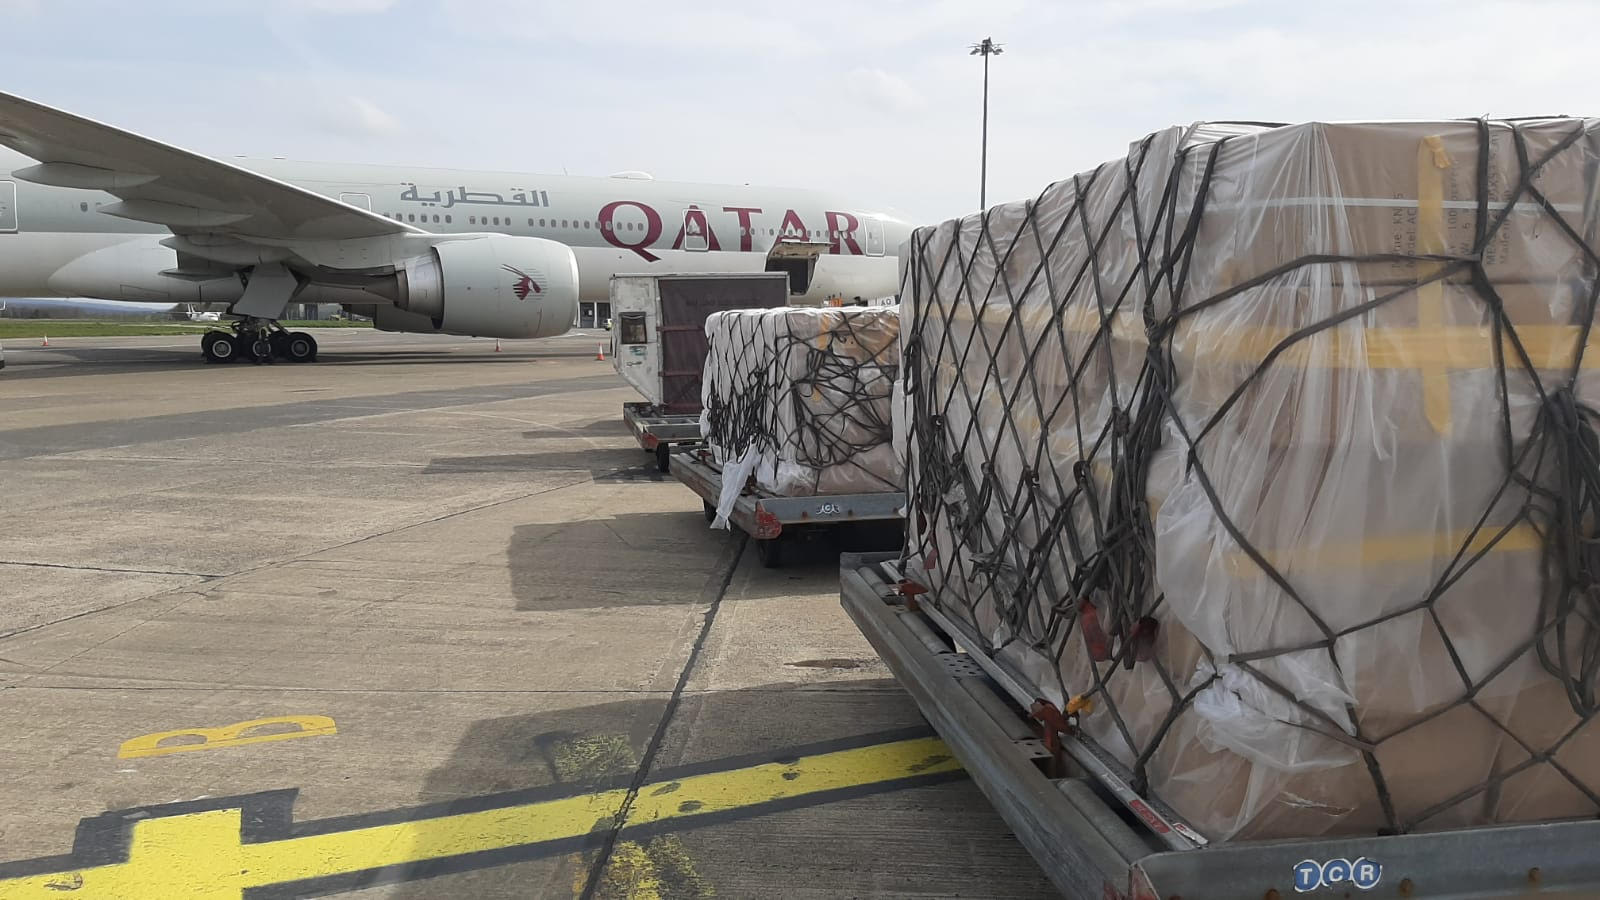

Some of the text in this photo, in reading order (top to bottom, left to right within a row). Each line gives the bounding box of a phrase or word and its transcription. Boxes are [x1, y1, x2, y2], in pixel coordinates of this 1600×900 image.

[400, 182, 549, 208] القطرية
[598, 200, 863, 263] QATAR
[117, 715, 337, 759] B
[1298, 862, 1375, 886] TCR
